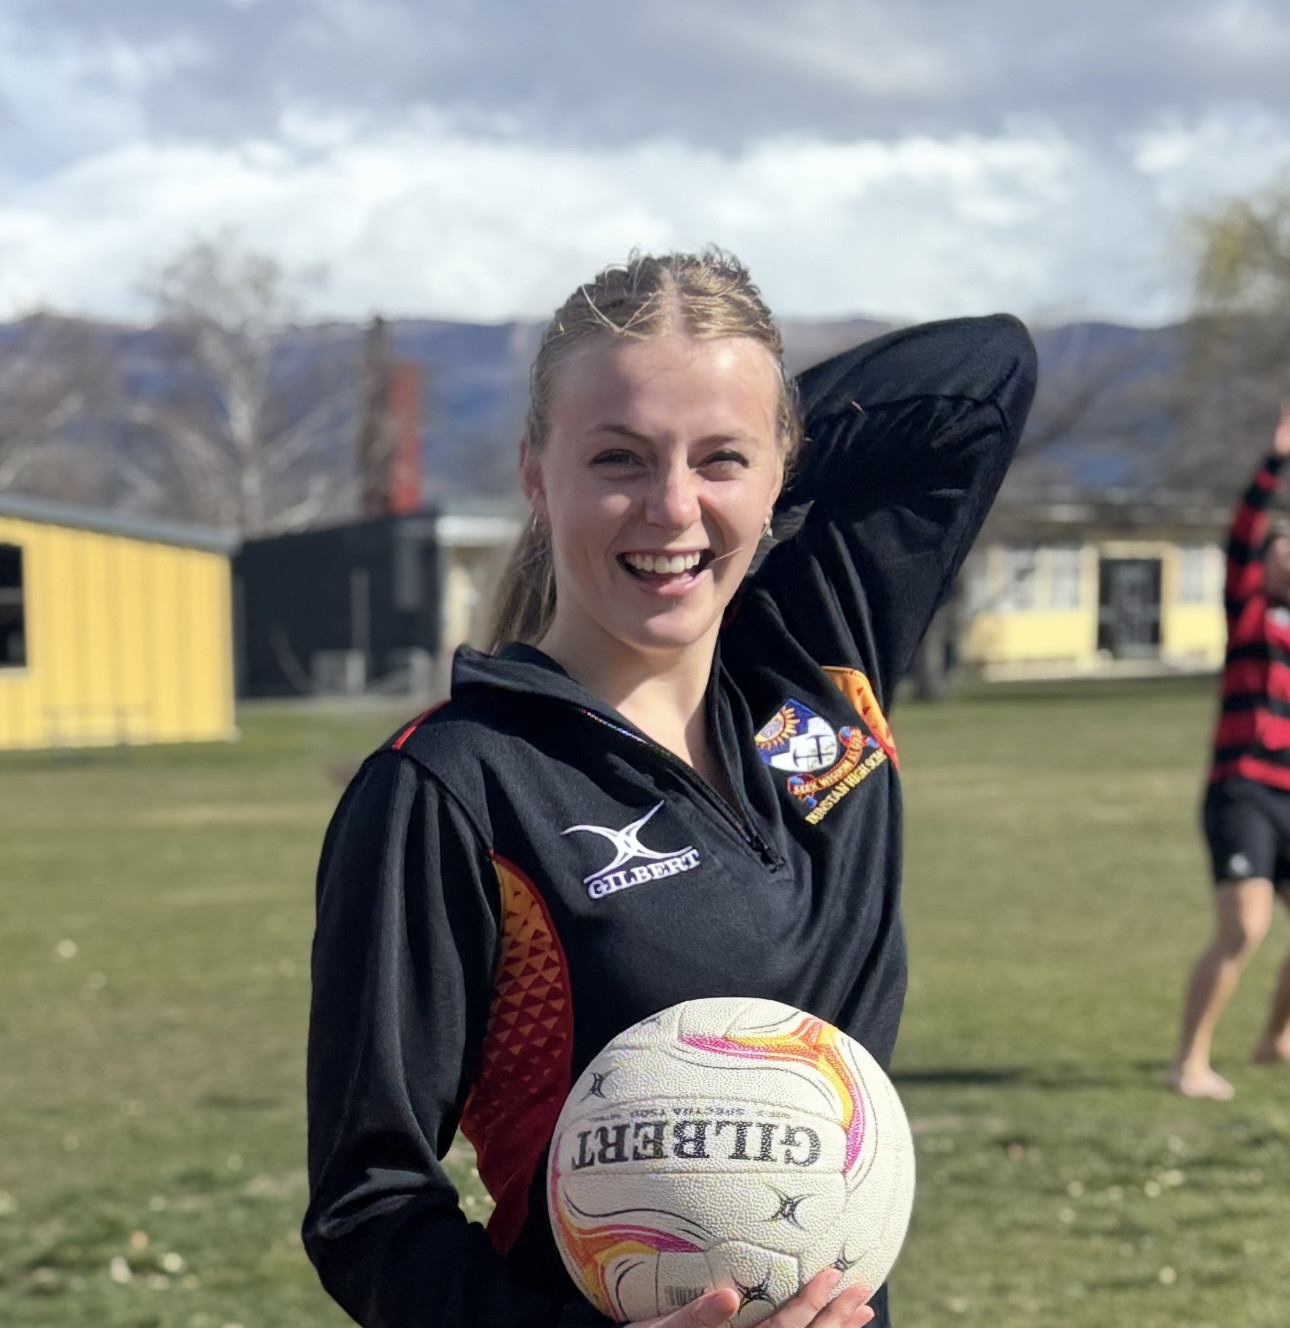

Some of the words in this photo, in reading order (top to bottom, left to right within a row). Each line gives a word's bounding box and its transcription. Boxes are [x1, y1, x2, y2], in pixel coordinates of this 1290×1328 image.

[804, 781, 850, 825] DUNSTAN
[844, 763, 872, 788] HIGH
[818, 758, 852, 788] WISDOM
[588, 849, 701, 899] GILBERT
[571, 1119, 822, 1171] GILBERT
